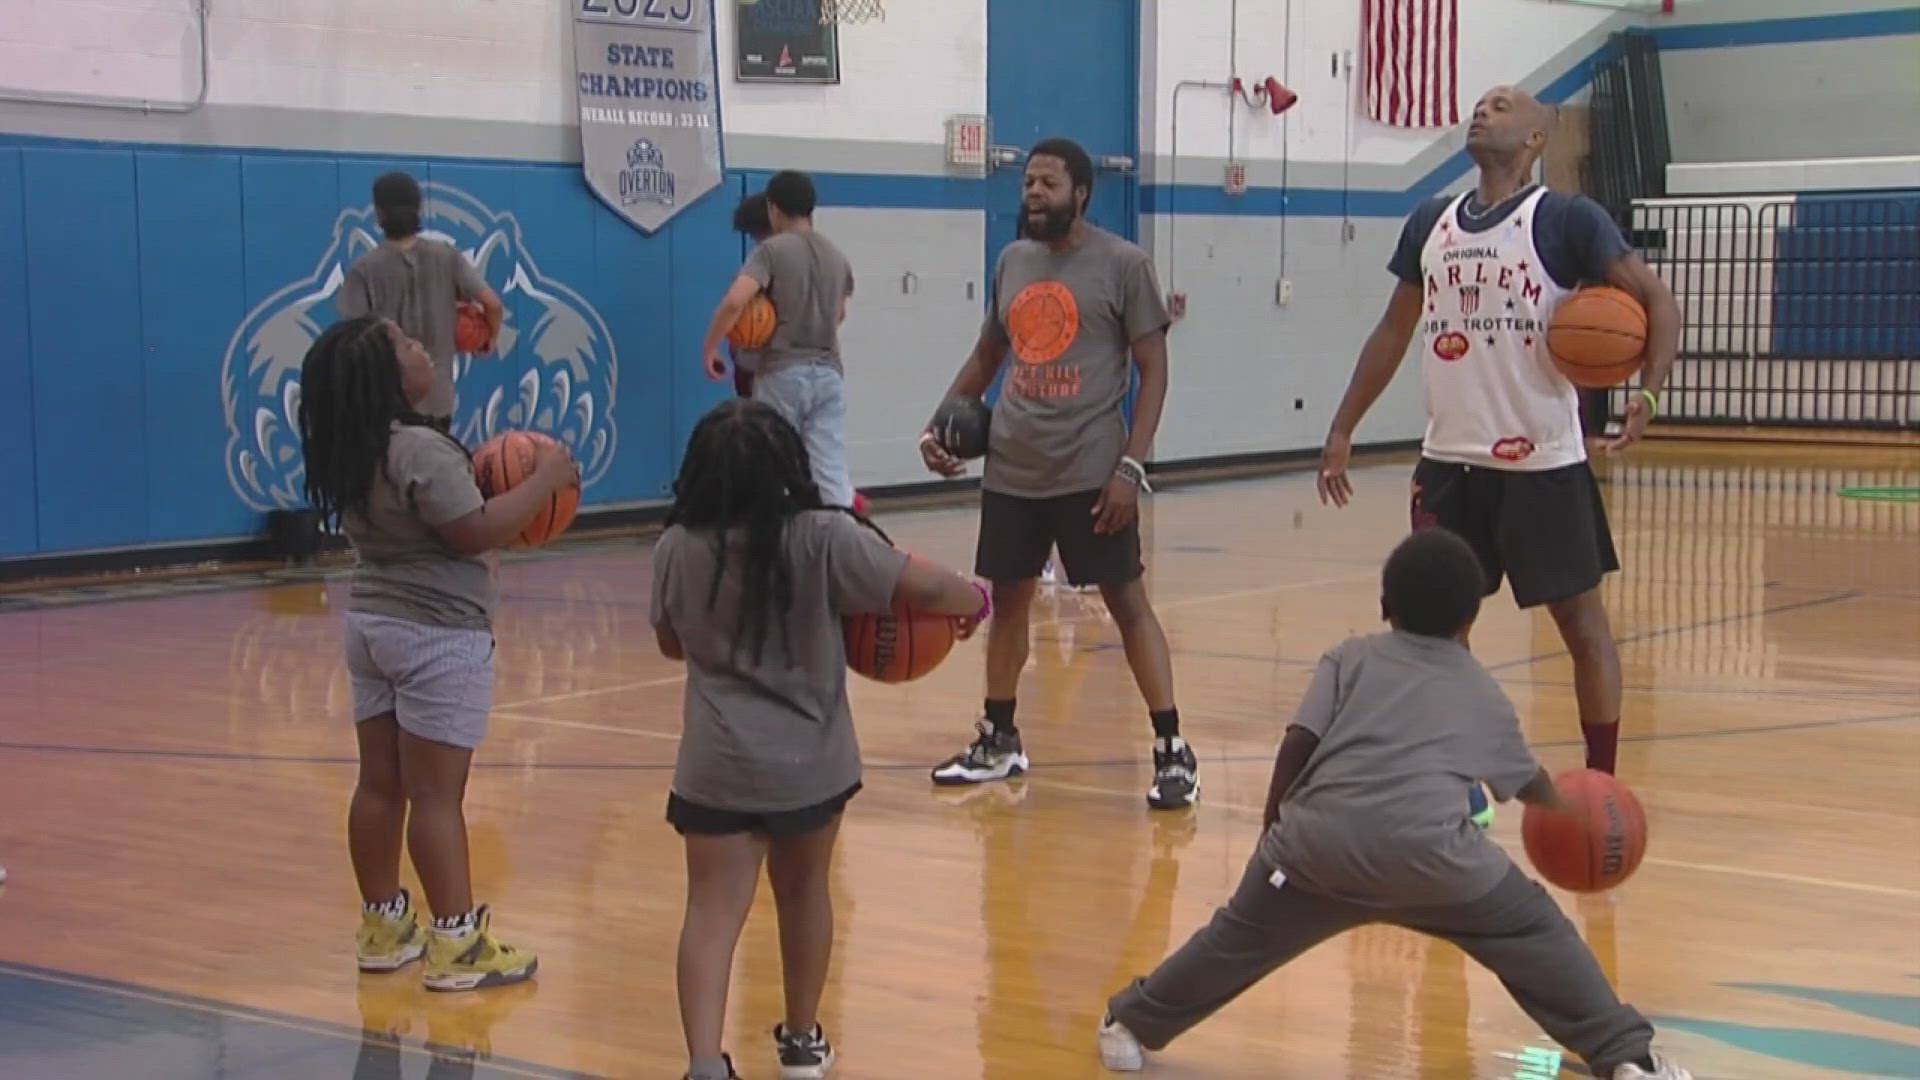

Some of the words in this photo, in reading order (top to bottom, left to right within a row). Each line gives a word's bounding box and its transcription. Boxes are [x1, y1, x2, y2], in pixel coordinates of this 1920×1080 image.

[607, 43, 674, 68] STATE
[579, 72, 707, 101] CHAMPIONS
[960, 125, 981, 151] EXIT
[619, 169, 675, 197] OVERTON
[1442, 247, 1499, 262] ORIGINAL
